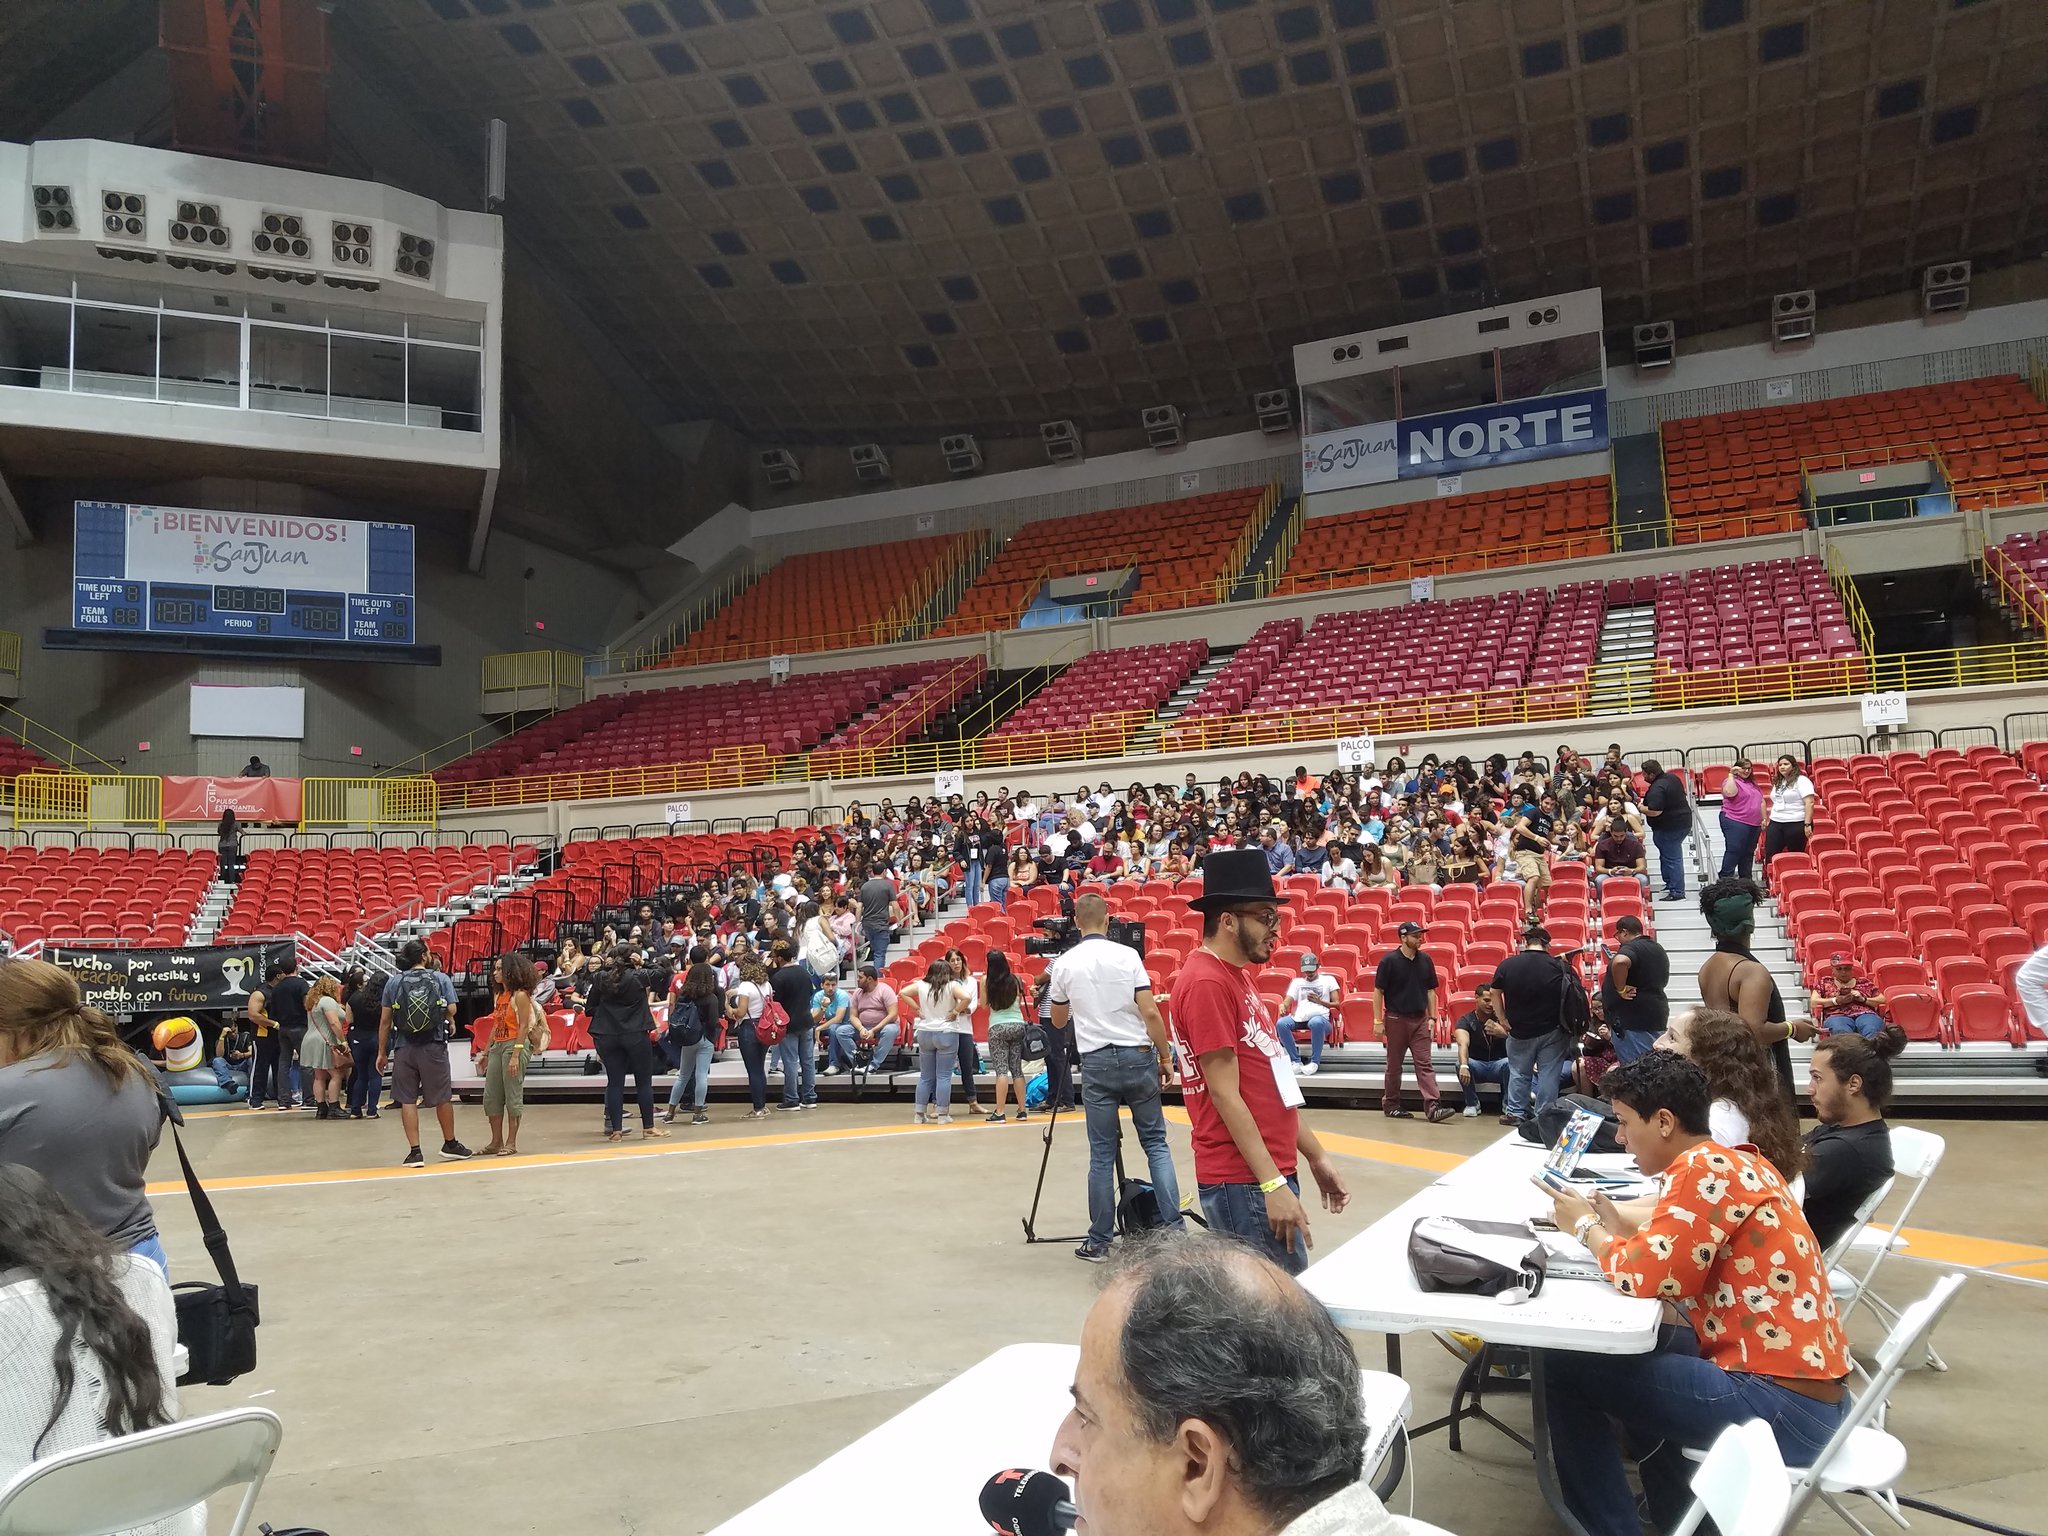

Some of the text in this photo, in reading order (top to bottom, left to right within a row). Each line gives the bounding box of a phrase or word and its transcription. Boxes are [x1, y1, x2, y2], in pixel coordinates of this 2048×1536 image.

[1409, 404, 1594, 465] NORTE
[154, 512, 347, 542] ¡BIENVENIDOS!
[77, 583, 123, 593] TIME OUTS
[90, 592, 110, 600] LEFT
[351, 598, 392, 608] TIME OUTS
[82, 606, 105, 615] TEAM
[361, 607, 380, 615] LEFT
[80, 615, 108, 624] FOULS
[224, 619, 253, 628] PERIOD
[355, 620, 376, 629] TEAM
[354, 628, 379, 636] FOULS
[1867, 698, 1900, 707] PALCO
[1880, 706, 1887, 714] H
[1341, 739, 1371, 751] PALCO
[1351, 750, 1361, 761] G
[667, 803, 689, 812] PALCO
[54, 948, 113, 971] Lucho
[128, 958, 153, 977] por
[137, 970, 189, 983] accesible
[192, 972, 201, 983] y
[86, 986, 208, 1005] pueblo con futuro
[88, 1000, 151, 1013] PRESENTE
